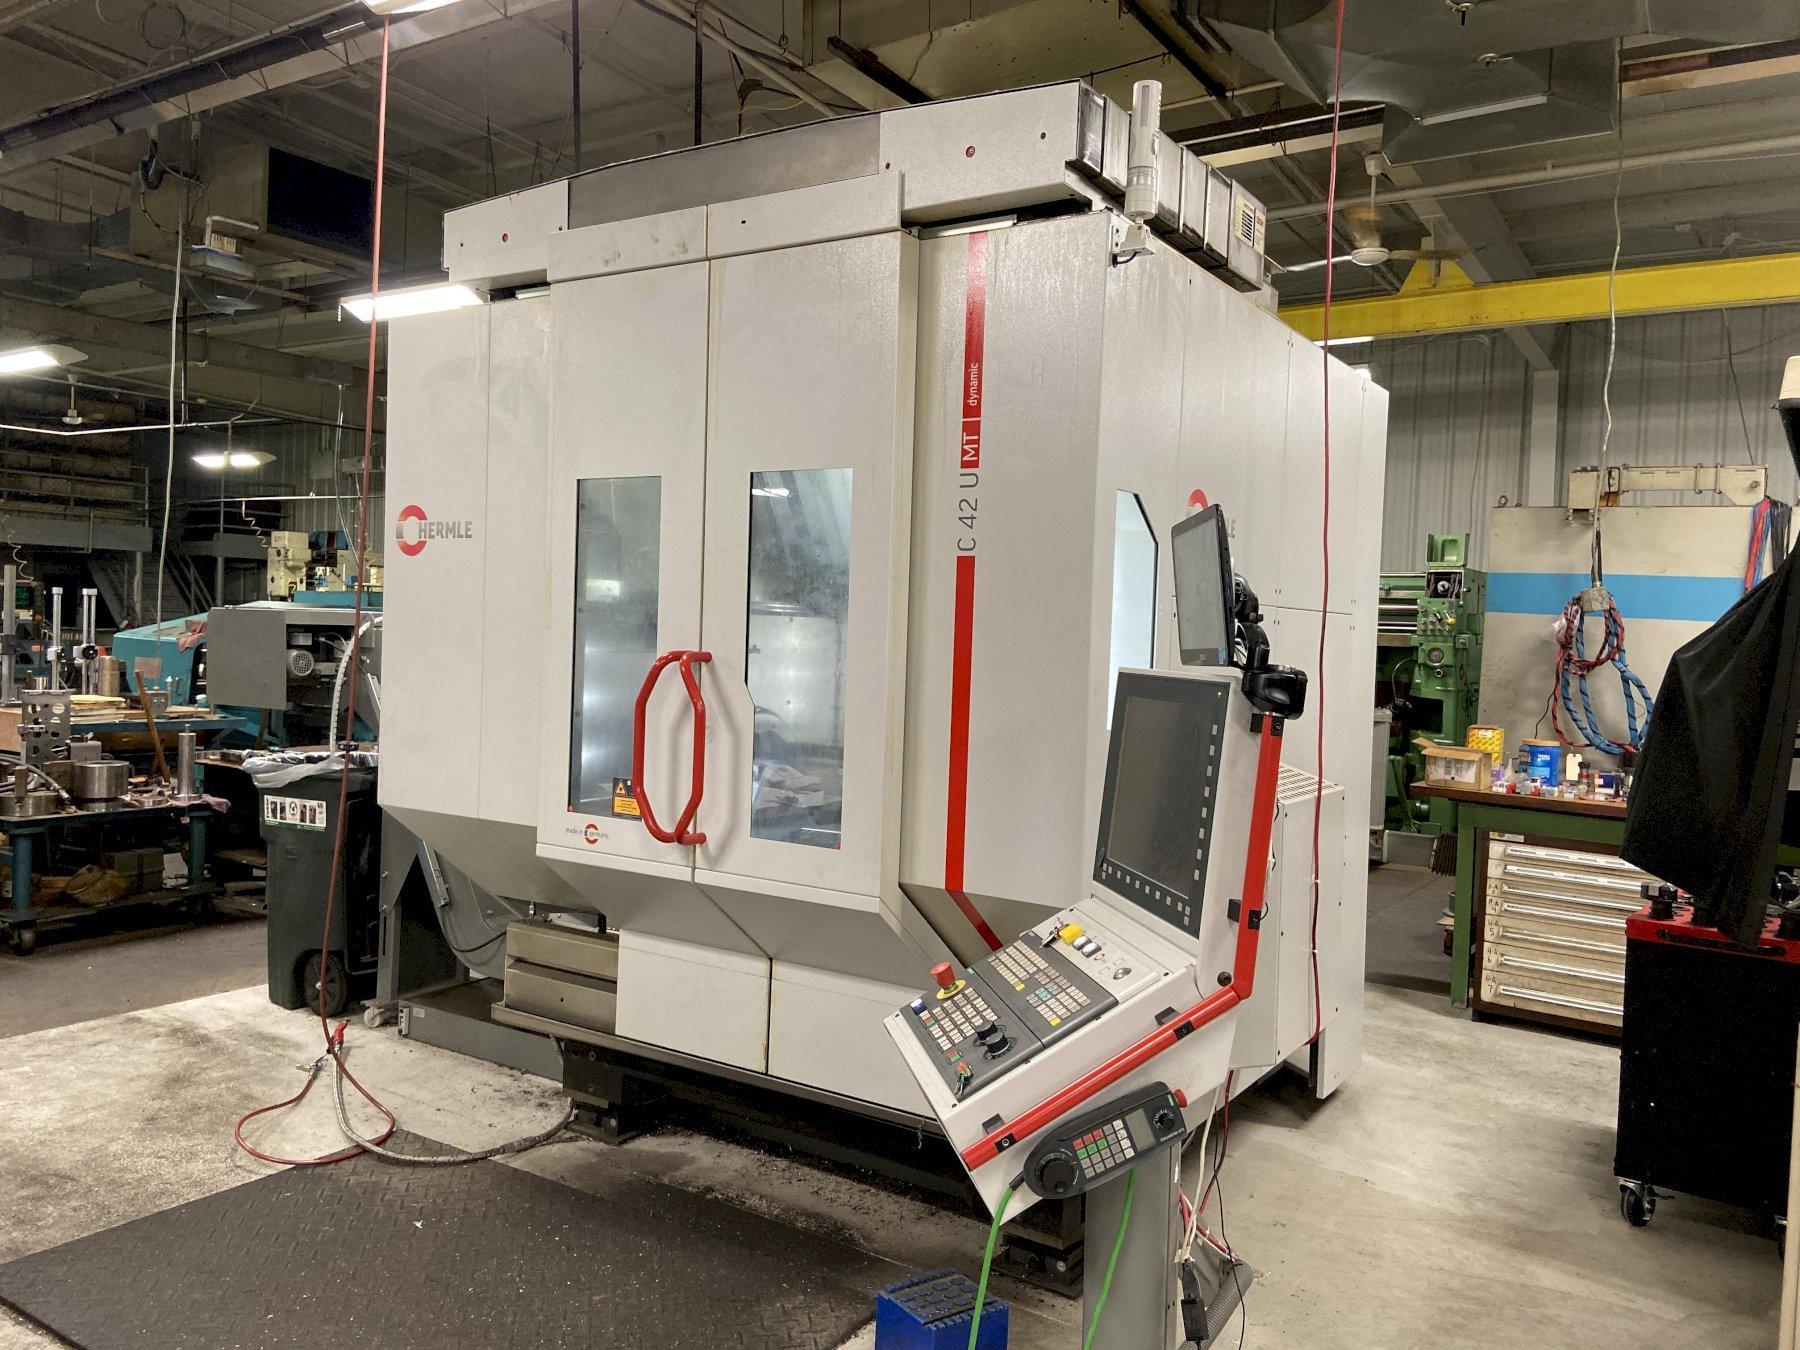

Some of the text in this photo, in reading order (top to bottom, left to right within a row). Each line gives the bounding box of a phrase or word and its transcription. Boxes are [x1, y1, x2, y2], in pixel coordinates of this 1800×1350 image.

[957, 362, 979, 552] C 42 U MT dynamic
[418, 520, 473, 539] HERMLE
